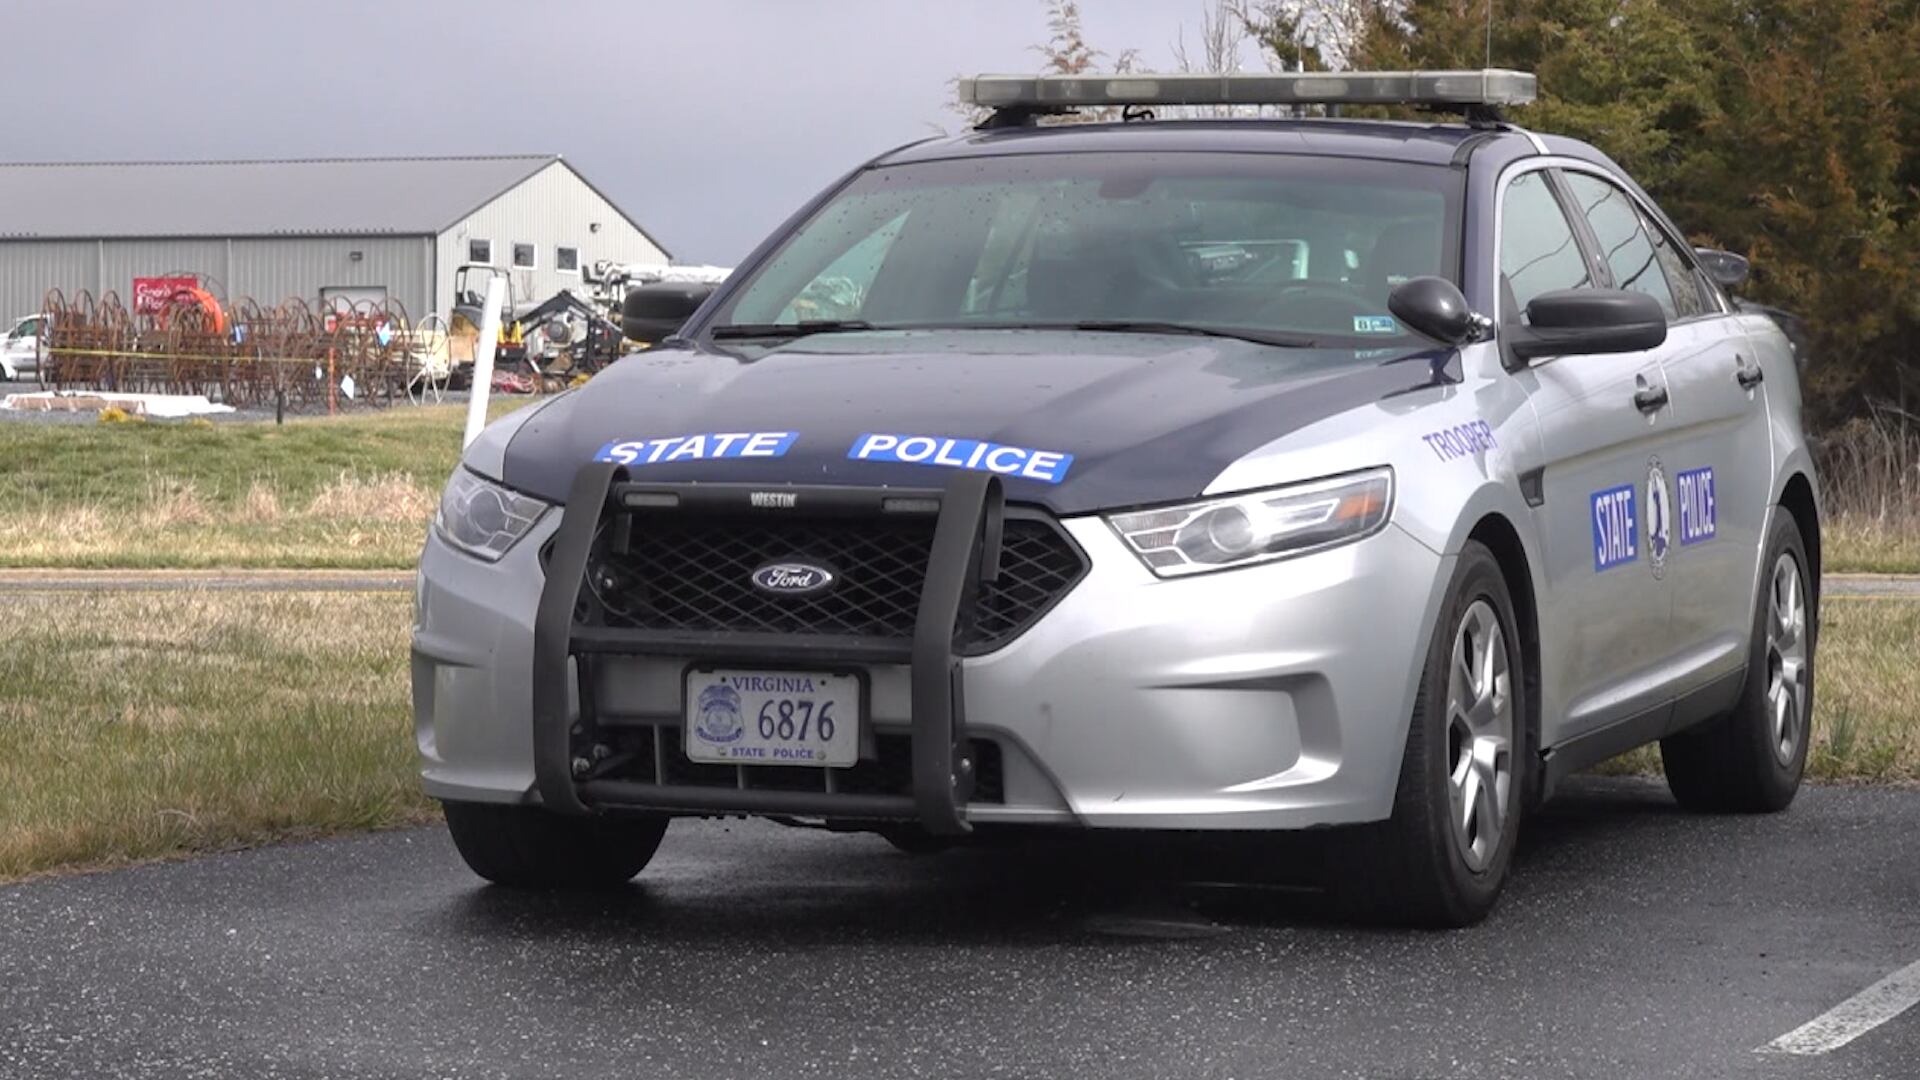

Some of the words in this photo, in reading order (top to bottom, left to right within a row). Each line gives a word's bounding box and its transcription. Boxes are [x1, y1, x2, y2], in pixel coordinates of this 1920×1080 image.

[603, 432, 788, 464] STATE
[857, 433, 1064, 480] POLICE
[1422, 420, 1498, 462] TROOPER
[750, 492, 797, 507] WESTIN
[1595, 490, 1635, 565] STATE
[1679, 471, 1715, 540] POLICE
[767, 568, 813, 587] Ford
[732, 676, 815, 693] VIRGINIA
[758, 699, 835, 742] 6876
[732, 747, 766, 758] STATE
[773, 748, 814, 760] POLICE
